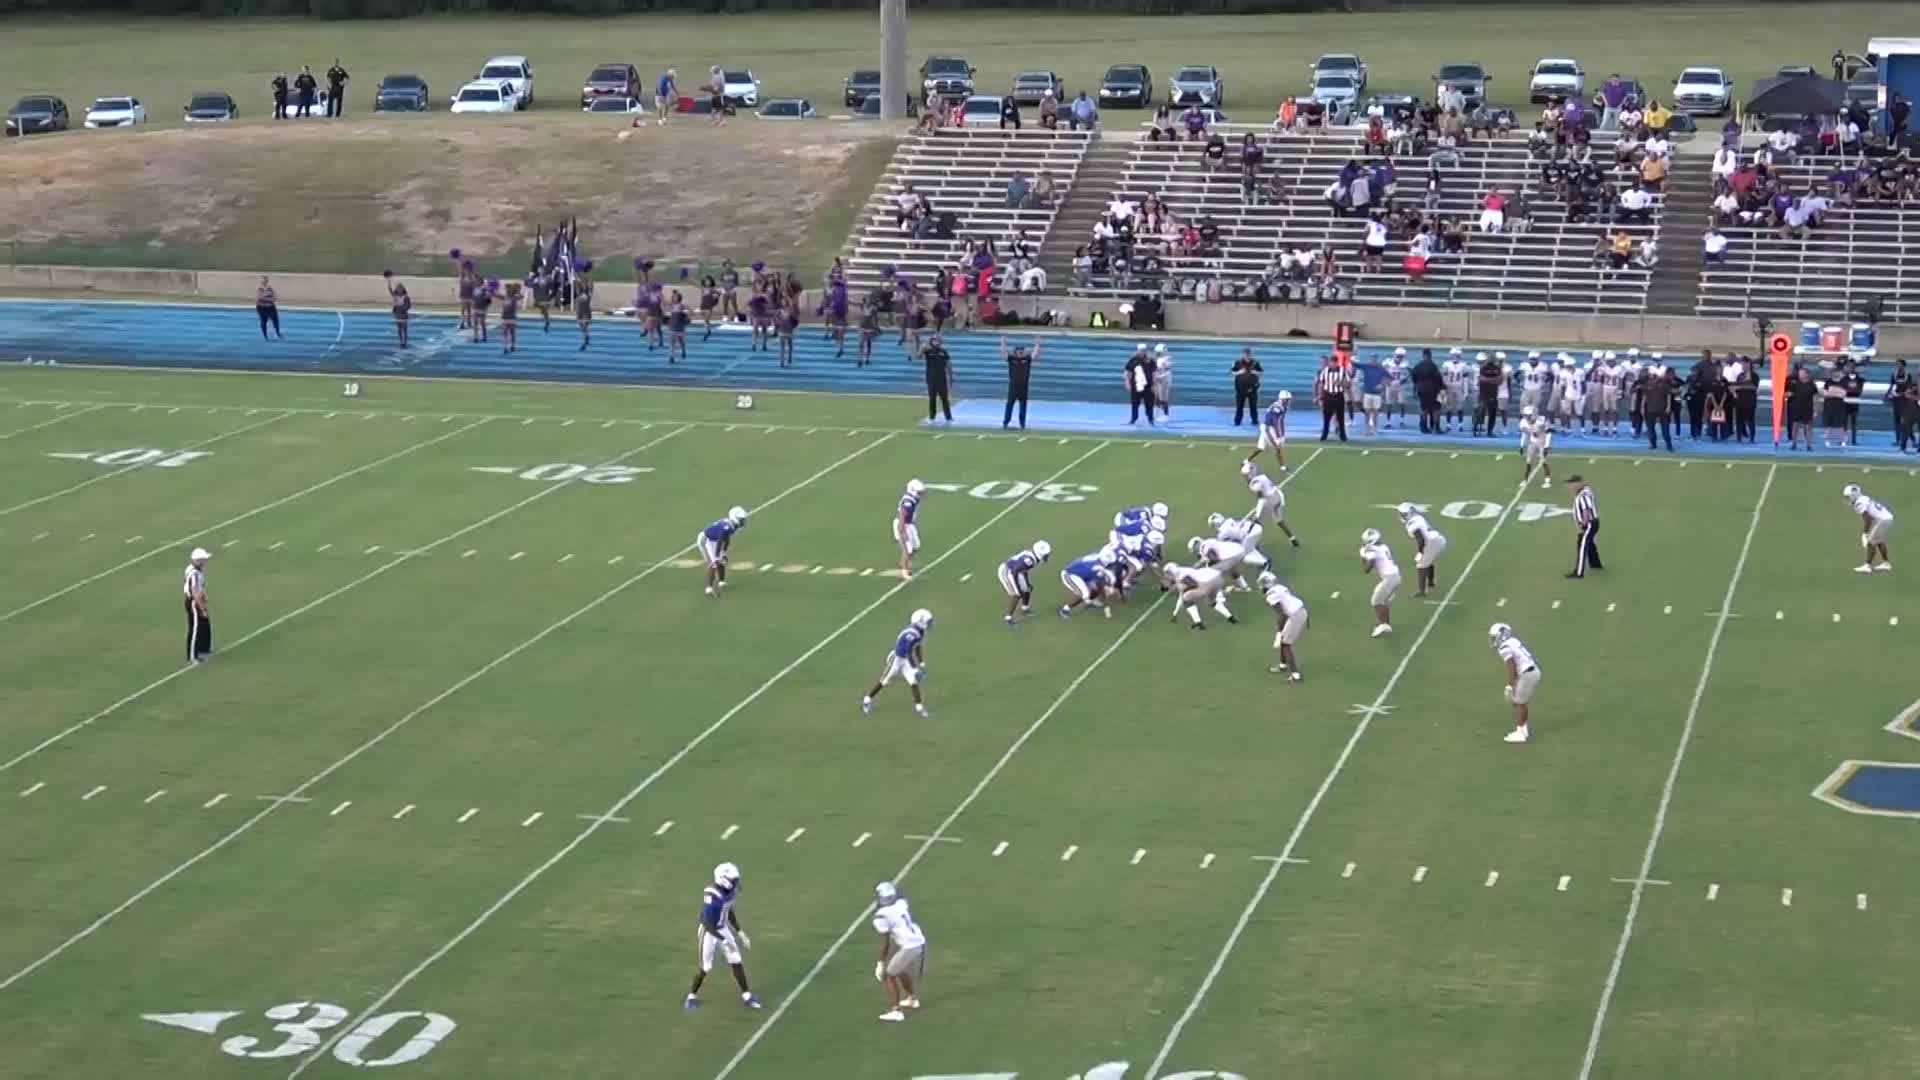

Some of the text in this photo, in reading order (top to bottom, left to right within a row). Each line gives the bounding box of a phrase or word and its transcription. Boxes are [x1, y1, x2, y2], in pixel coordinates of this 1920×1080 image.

[343, 383, 359, 396] 10
[736, 395, 752, 408] 20
[93, 449, 214, 466] 10
[519, 463, 656, 484] 20
[968, 480, 1099, 502] 30
[1440, 500, 1573, 522] 40
[221, 1001, 457, 1067] 30
